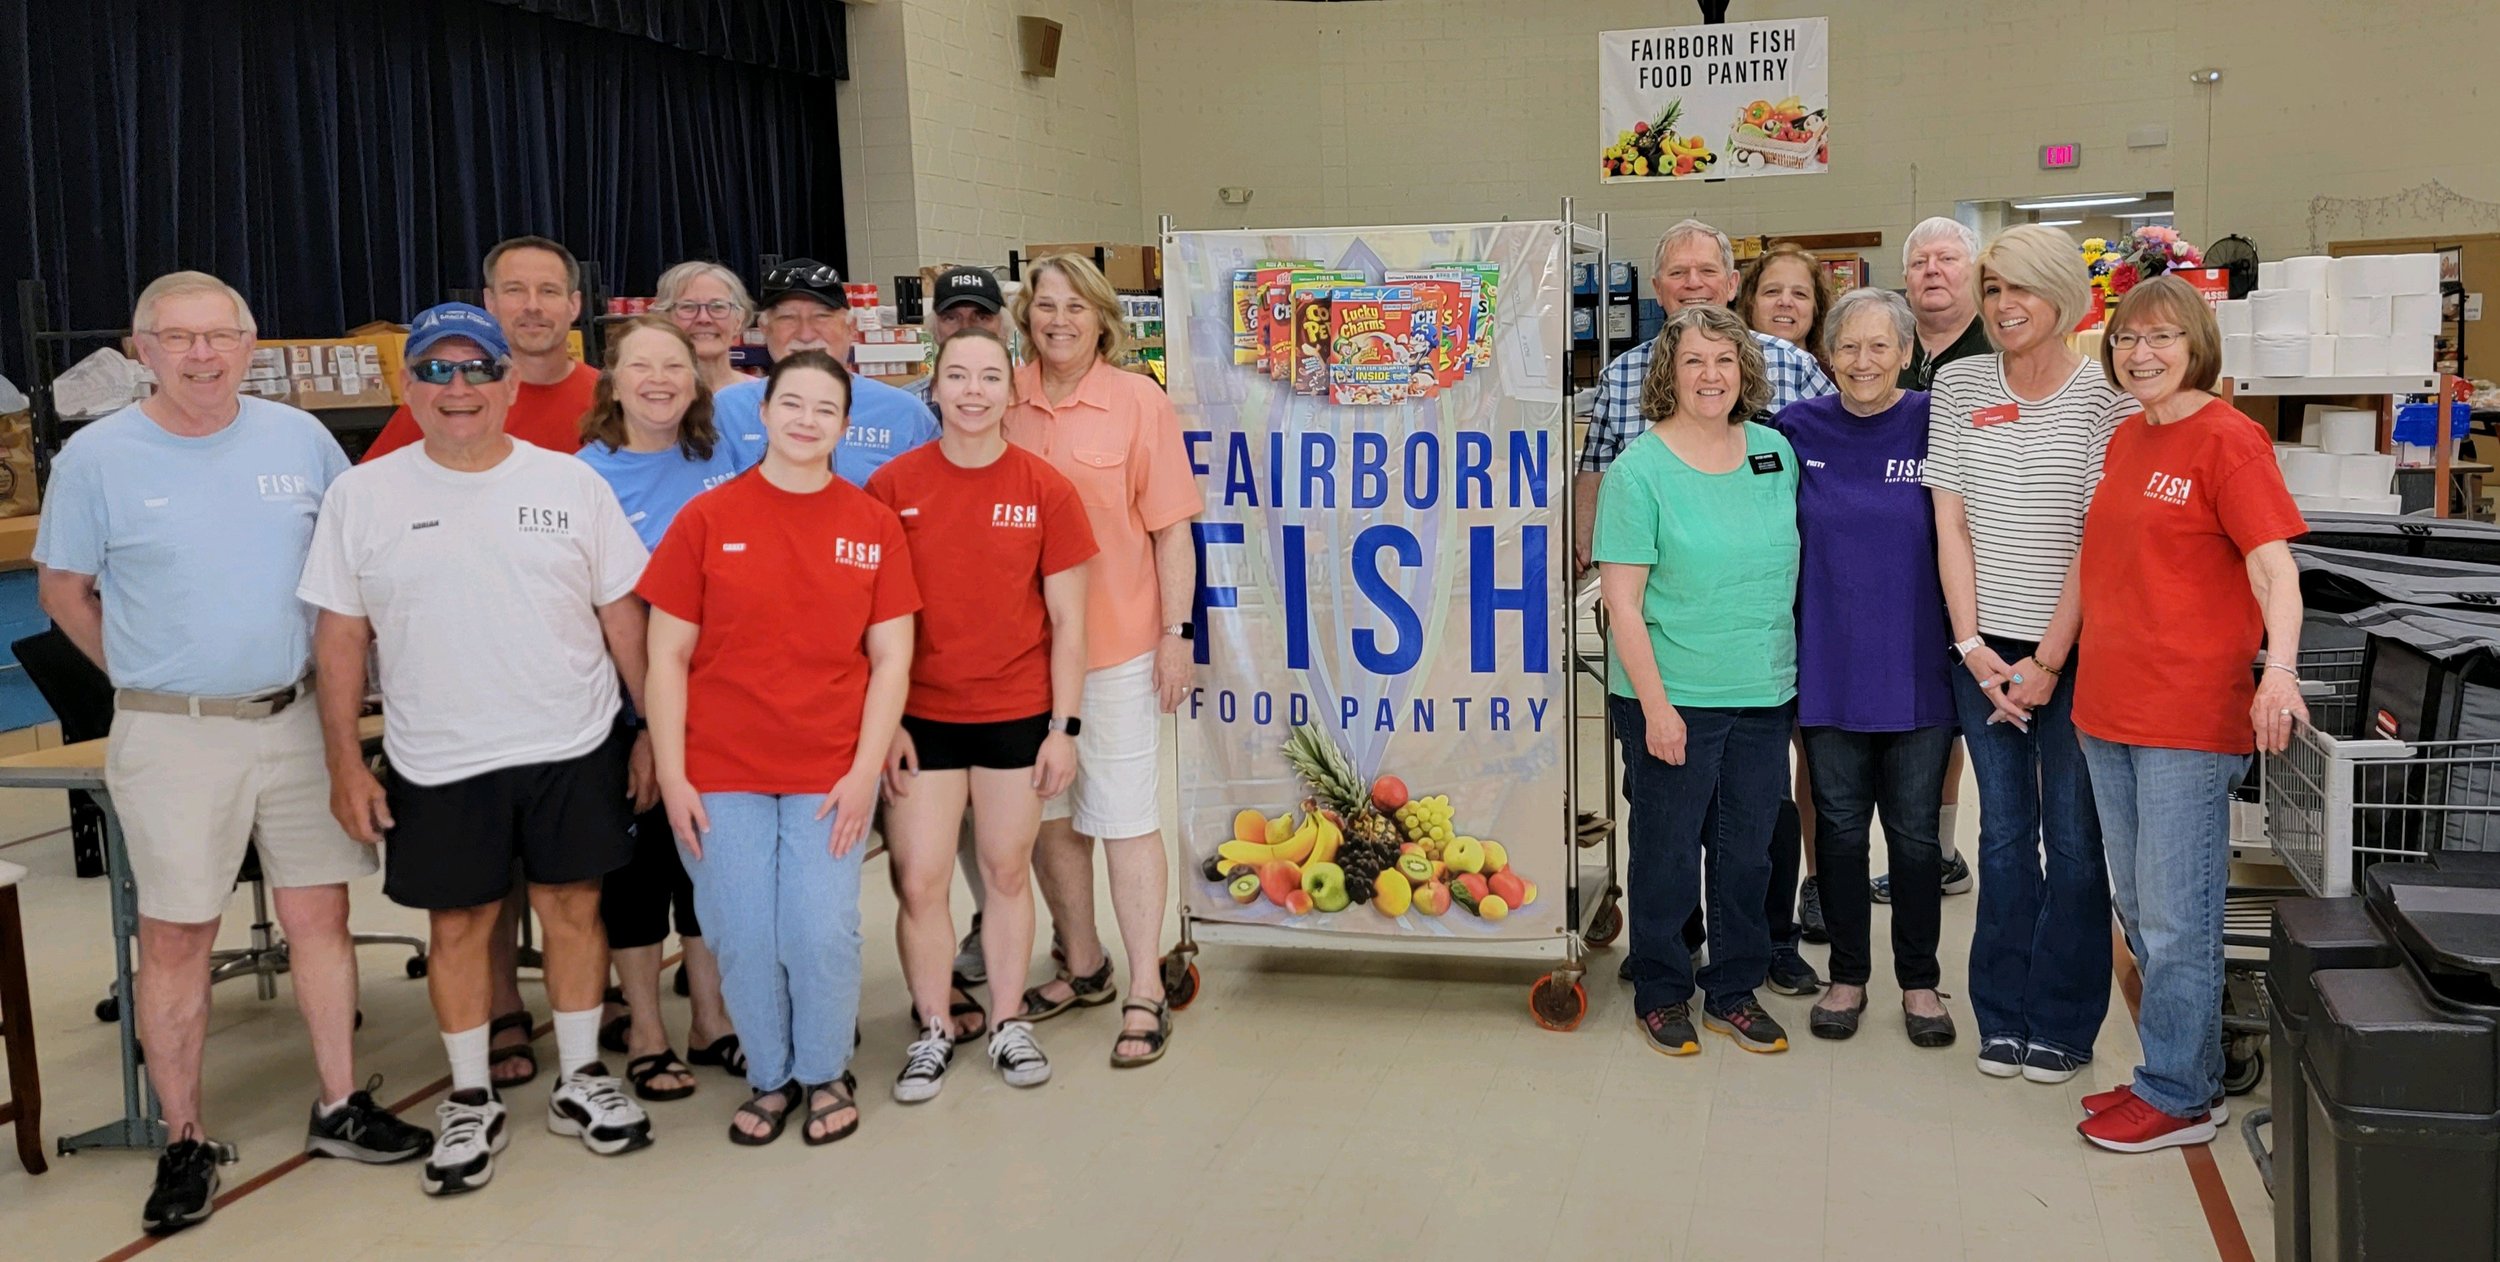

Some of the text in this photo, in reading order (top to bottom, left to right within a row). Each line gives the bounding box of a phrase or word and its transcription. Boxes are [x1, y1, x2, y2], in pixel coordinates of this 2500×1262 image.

[1631, 29, 1796, 61] FAIRBORN FISH
[1640, 58, 1788, 89] FOOD PANTRY
[951, 274, 983, 288] FISH
[1341, 304, 1379, 323] Lucky
[1340, 319, 1386, 338] Charms
[1356, 371, 1391, 380] INSIDE
[846, 425, 890, 443] FISH
[1182, 430, 1549, 510] FAIRBORN
[1886, 458, 1927, 477] FISH
[2147, 471, 2192, 499] FISH
[519, 506, 569, 530] FISH
[991, 503, 1037, 522] FISH
[835, 537, 881, 563] FISH
[1191, 522, 1549, 676] FISH
[1190, 687, 1549, 733] FOOD PANTRY
